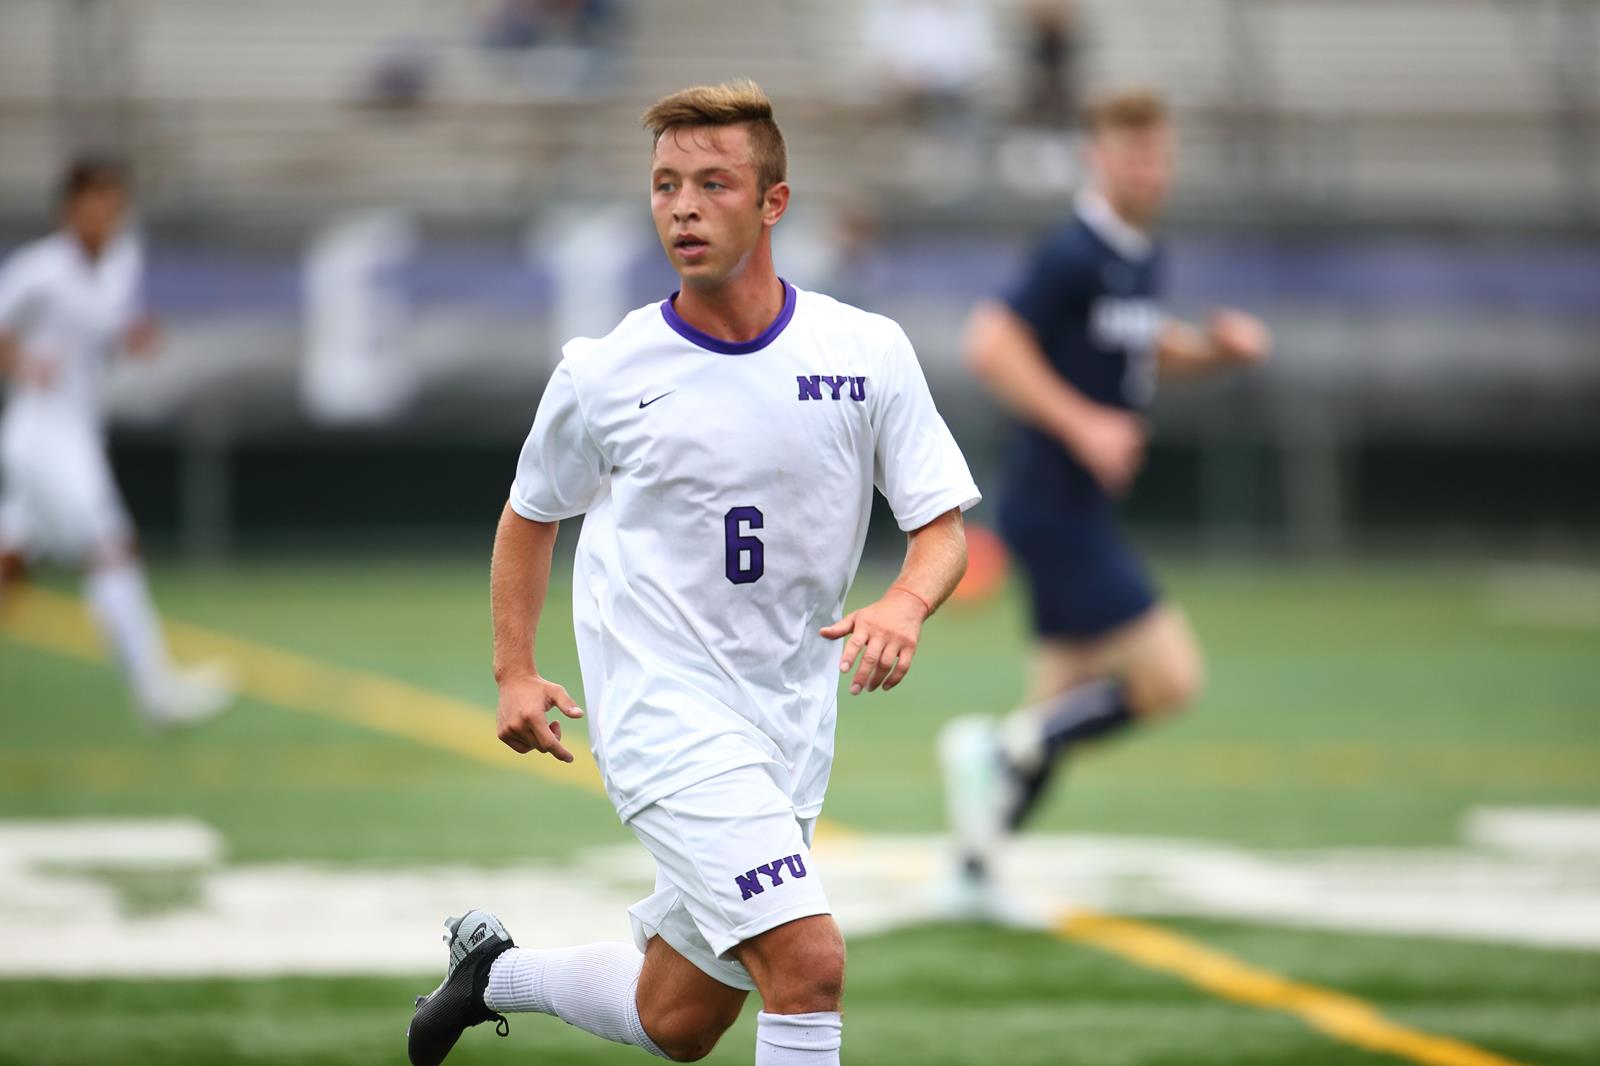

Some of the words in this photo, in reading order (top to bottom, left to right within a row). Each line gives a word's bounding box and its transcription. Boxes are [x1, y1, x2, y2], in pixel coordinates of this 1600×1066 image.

[797, 375, 866, 401] NYU
[724, 506, 764, 585] 6
[735, 854, 807, 901] NYU
